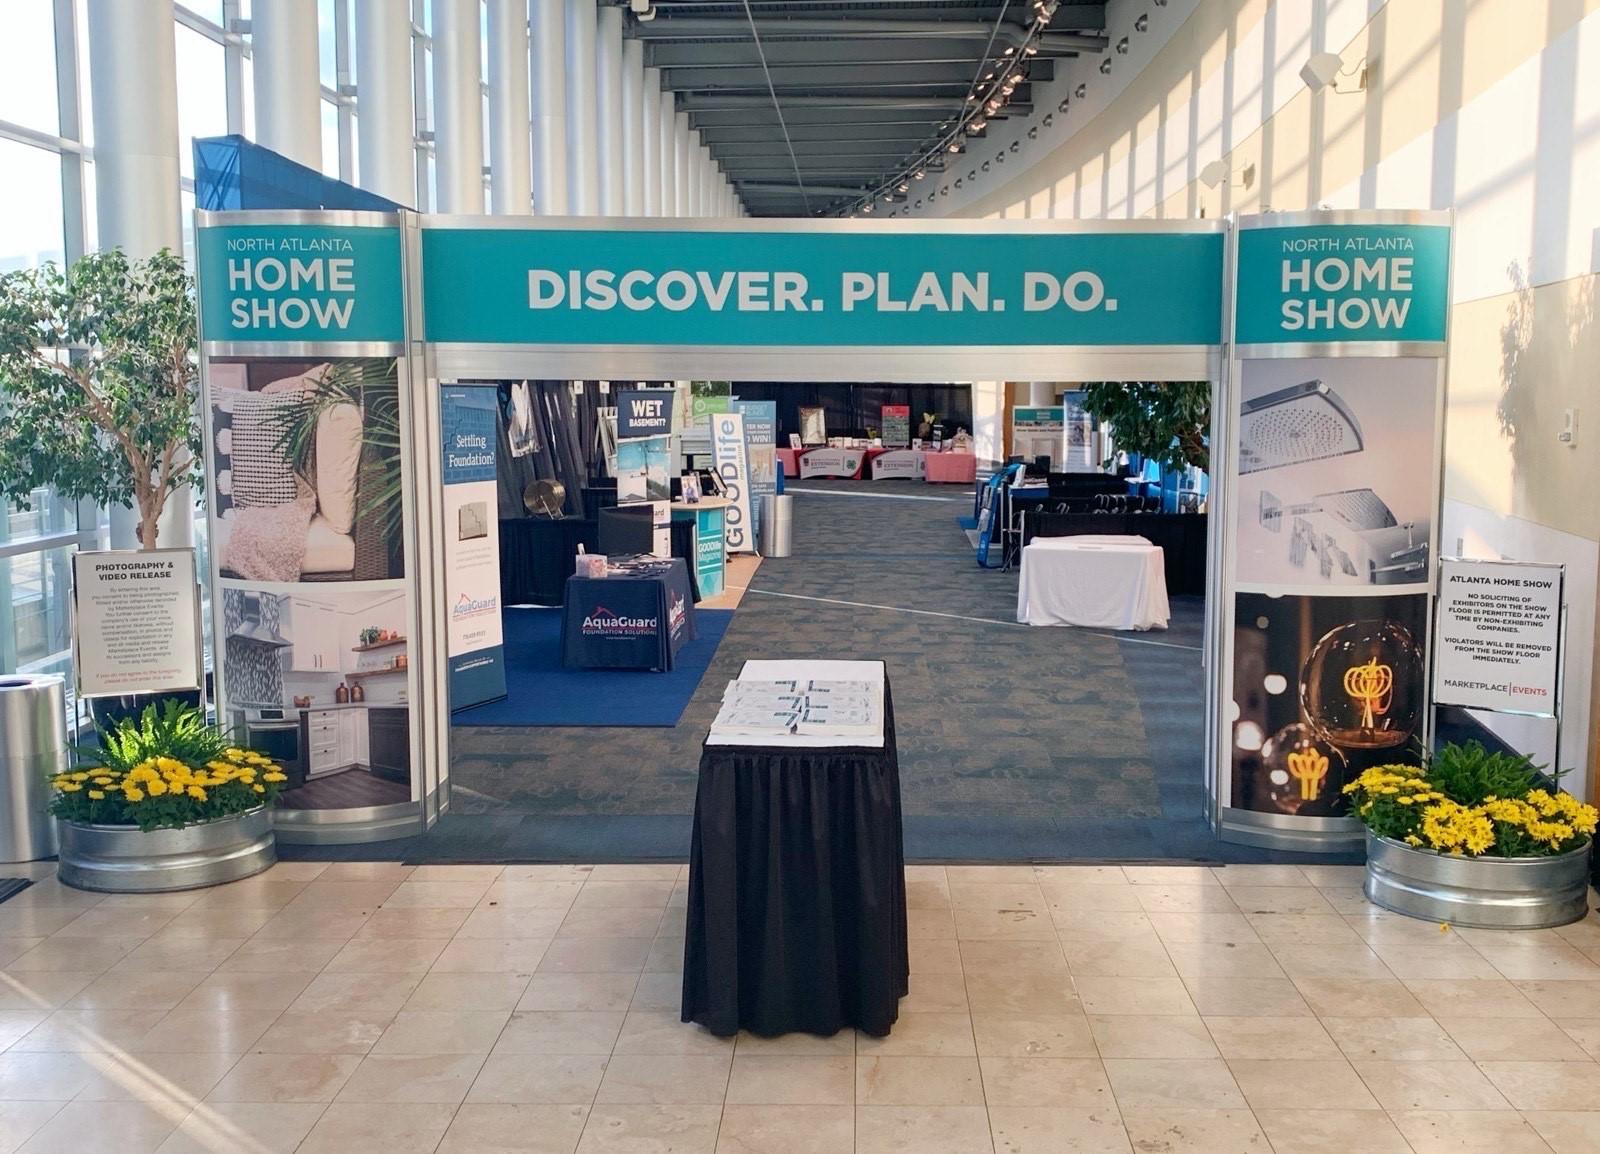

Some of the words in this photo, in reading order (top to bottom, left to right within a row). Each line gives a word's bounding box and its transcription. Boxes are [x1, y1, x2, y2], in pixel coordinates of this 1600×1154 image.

[227, 238, 275, 251] NORTH
[280, 237, 354, 251] ATLANTA
[1282, 238, 1340, 253] NORTH
[1344, 237, 1414, 251] ATLANTA
[228, 257, 356, 292] HOME
[1281, 257, 1414, 293] HOME
[528, 268, 823, 312] DISCOVER.
[842, 271, 1006, 312] PLAN.
[1023, 270, 1118, 312] DO.
[231, 297, 355, 329] SHOW
[1280, 297, 1412, 331] SHOW
[631, 400, 663, 416] WET
[629, 418, 666, 428] BASEMENT?
[456, 434, 487, 449] Settling
[449, 452, 495, 468] Foundation?
[95, 561, 165, 572] PHOTOGRAPHY
[167, 561, 174, 569] &
[98, 573, 127, 581] VIDEO
[130, 571, 171, 580] RELEASE
[1450, 575, 1491, 585] ATLANTA
[1493, 578, 1521, 587] HOME
[1523, 579, 1553, 589] SHOW
[1480, 594, 1520, 603] SOLICITING
[1452, 600, 1495, 608] EXHIBITORS
[1509, 603, 1523, 611] THE
[1524, 604, 1547, 612] SHOW
[1482, 609, 1522, 618] PERMITTED
[1523, 611, 1533, 619] AT
[1535, 612, 1551, 620] ANY
[1484, 616, 1544, 627] NON-EXHIBITING
[582, 616, 658, 630] AquaGuard
[1476, 624, 1520, 634] COMPANIES.
[1444, 637, 1485, 646] VIOLATORS
[1486, 640, 1503, 648] WILL
[1505, 641, 1515, 649] BE
[1516, 642, 1552, 652] REMOVED
[1472, 654, 1522, 665] IMMEDIATELY.
[1492, 647, 1514, 656] SHOW
[1515, 649, 1541, 659] FLOOR
[1444, 679, 1509, 693] MARKETPLACE
[1512, 686, 1548, 696] EVENTS
